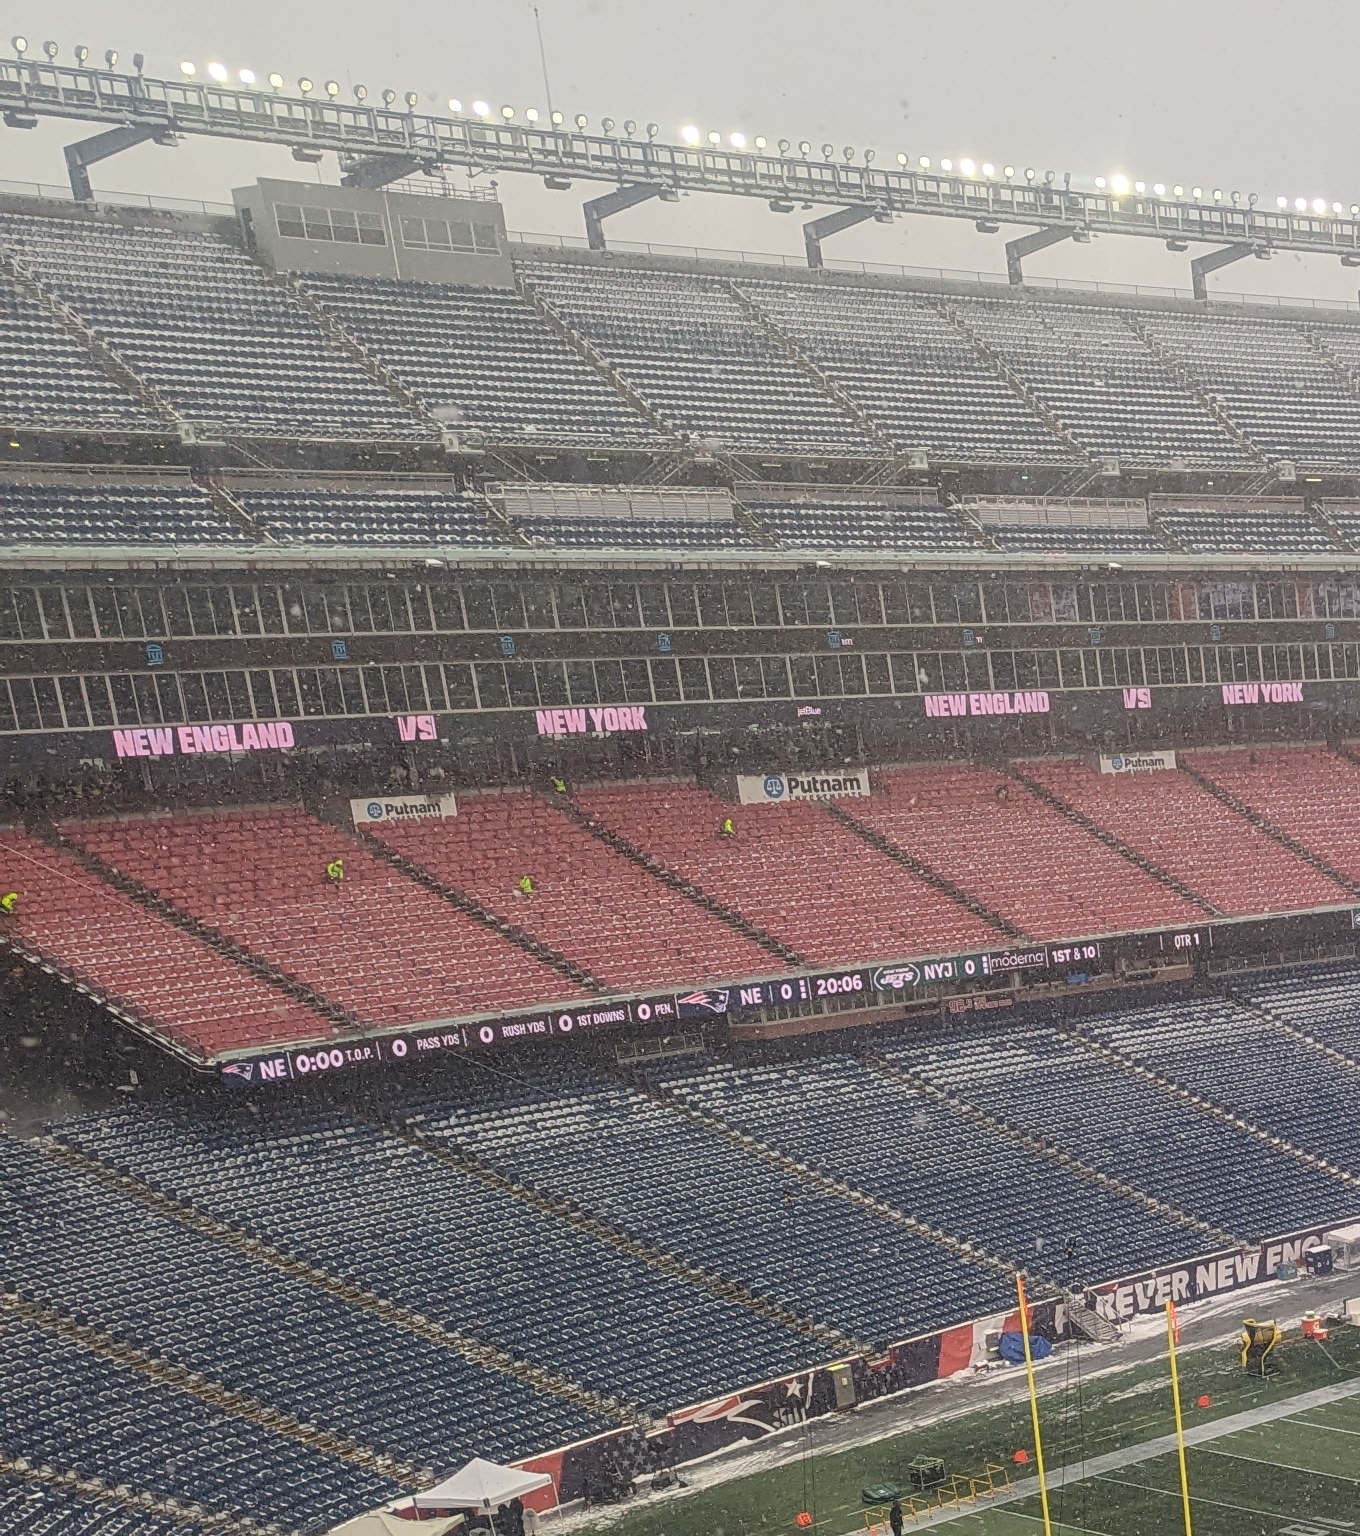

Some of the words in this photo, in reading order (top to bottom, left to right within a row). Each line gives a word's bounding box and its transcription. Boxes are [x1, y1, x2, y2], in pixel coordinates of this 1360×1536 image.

[924, 694, 967, 717] NEW
[969, 690, 1050, 716] ENGLAND
[1222, 683, 1259, 705] NEW
[1260, 682, 1304, 703] YORK
[534, 709, 586, 735] NEW
[587, 706, 649, 732] YORK
[112, 727, 175, 758] NEW
[176, 721, 296, 754] ENGLAND
[1124, 757, 1165, 769] Putnam
[786, 775, 861, 794] Putnam
[384, 801, 442, 817] Putnam
[1173, 935, 1193, 949] QTR
[990, 953, 1044, 970] moderna
[1051, 950, 1071, 964] 1ST
[1083, 946, 1096, 961] 10
[923, 961, 953, 981] NYJ
[964, 958, 976, 976] 0
[739, 986, 763, 1006] NE
[780, 983, 793, 1001] 0
[816, 974, 863, 996] 20:06
[258, 1057, 288, 1080] NE
[296, 1048, 345, 1074] 0:00
[391, 1038, 408, 1058] 0
[416, 1036, 441, 1051] PASS
[441, 1033, 460, 1048] YDS
[479, 1025, 495, 1045] 0
[502, 1023, 526, 1038] RUSH
[526, 1020, 546, 1036] YDS
[558, 1013, 574, 1032] 0
[576, 1013, 593, 1028] 1ST
[593, 1008, 626, 1025] DOWNS
[636, 1003, 652, 1021] 0
[1054, 1269, 1190, 1335] FREVER
[1195, 1253, 1261, 1294] NEW
